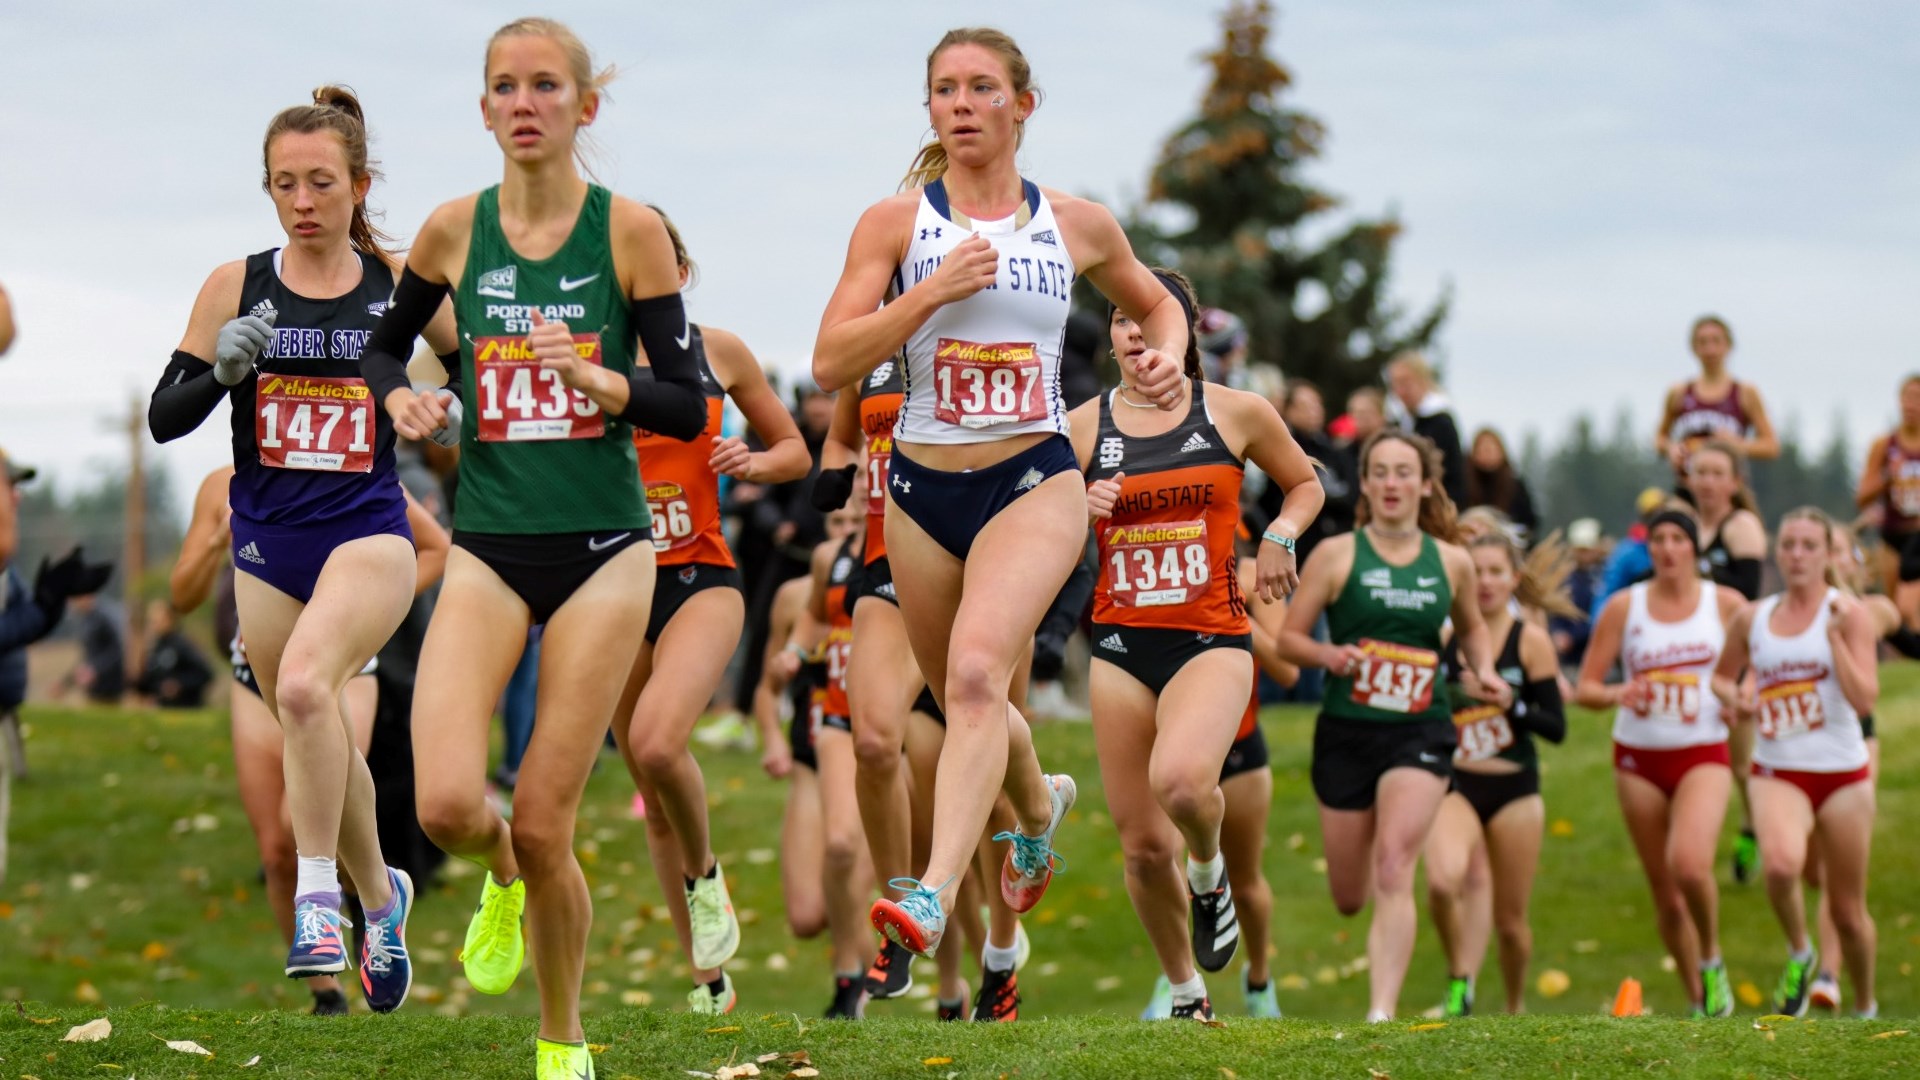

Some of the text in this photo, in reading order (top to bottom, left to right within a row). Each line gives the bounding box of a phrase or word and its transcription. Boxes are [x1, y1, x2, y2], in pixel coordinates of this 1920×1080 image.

[492, 268, 514, 286] SKY
[1009, 257, 1067, 301] STATE
[486, 304, 586, 319] PORTAND
[331, 330, 373, 360] STA
[938, 366, 1039, 413] 1387
[261, 402, 370, 452] 1471
[1180, 442, 1212, 452] adidas
[1112, 484, 1214, 516] AHO STATE
[647, 501, 692, 539] 56
[238, 550, 266, 565] adidas
[1111, 543, 1209, 591] 1348
[1099, 640, 1128, 653] adidas
[1355, 659, 1435, 702] 1437
